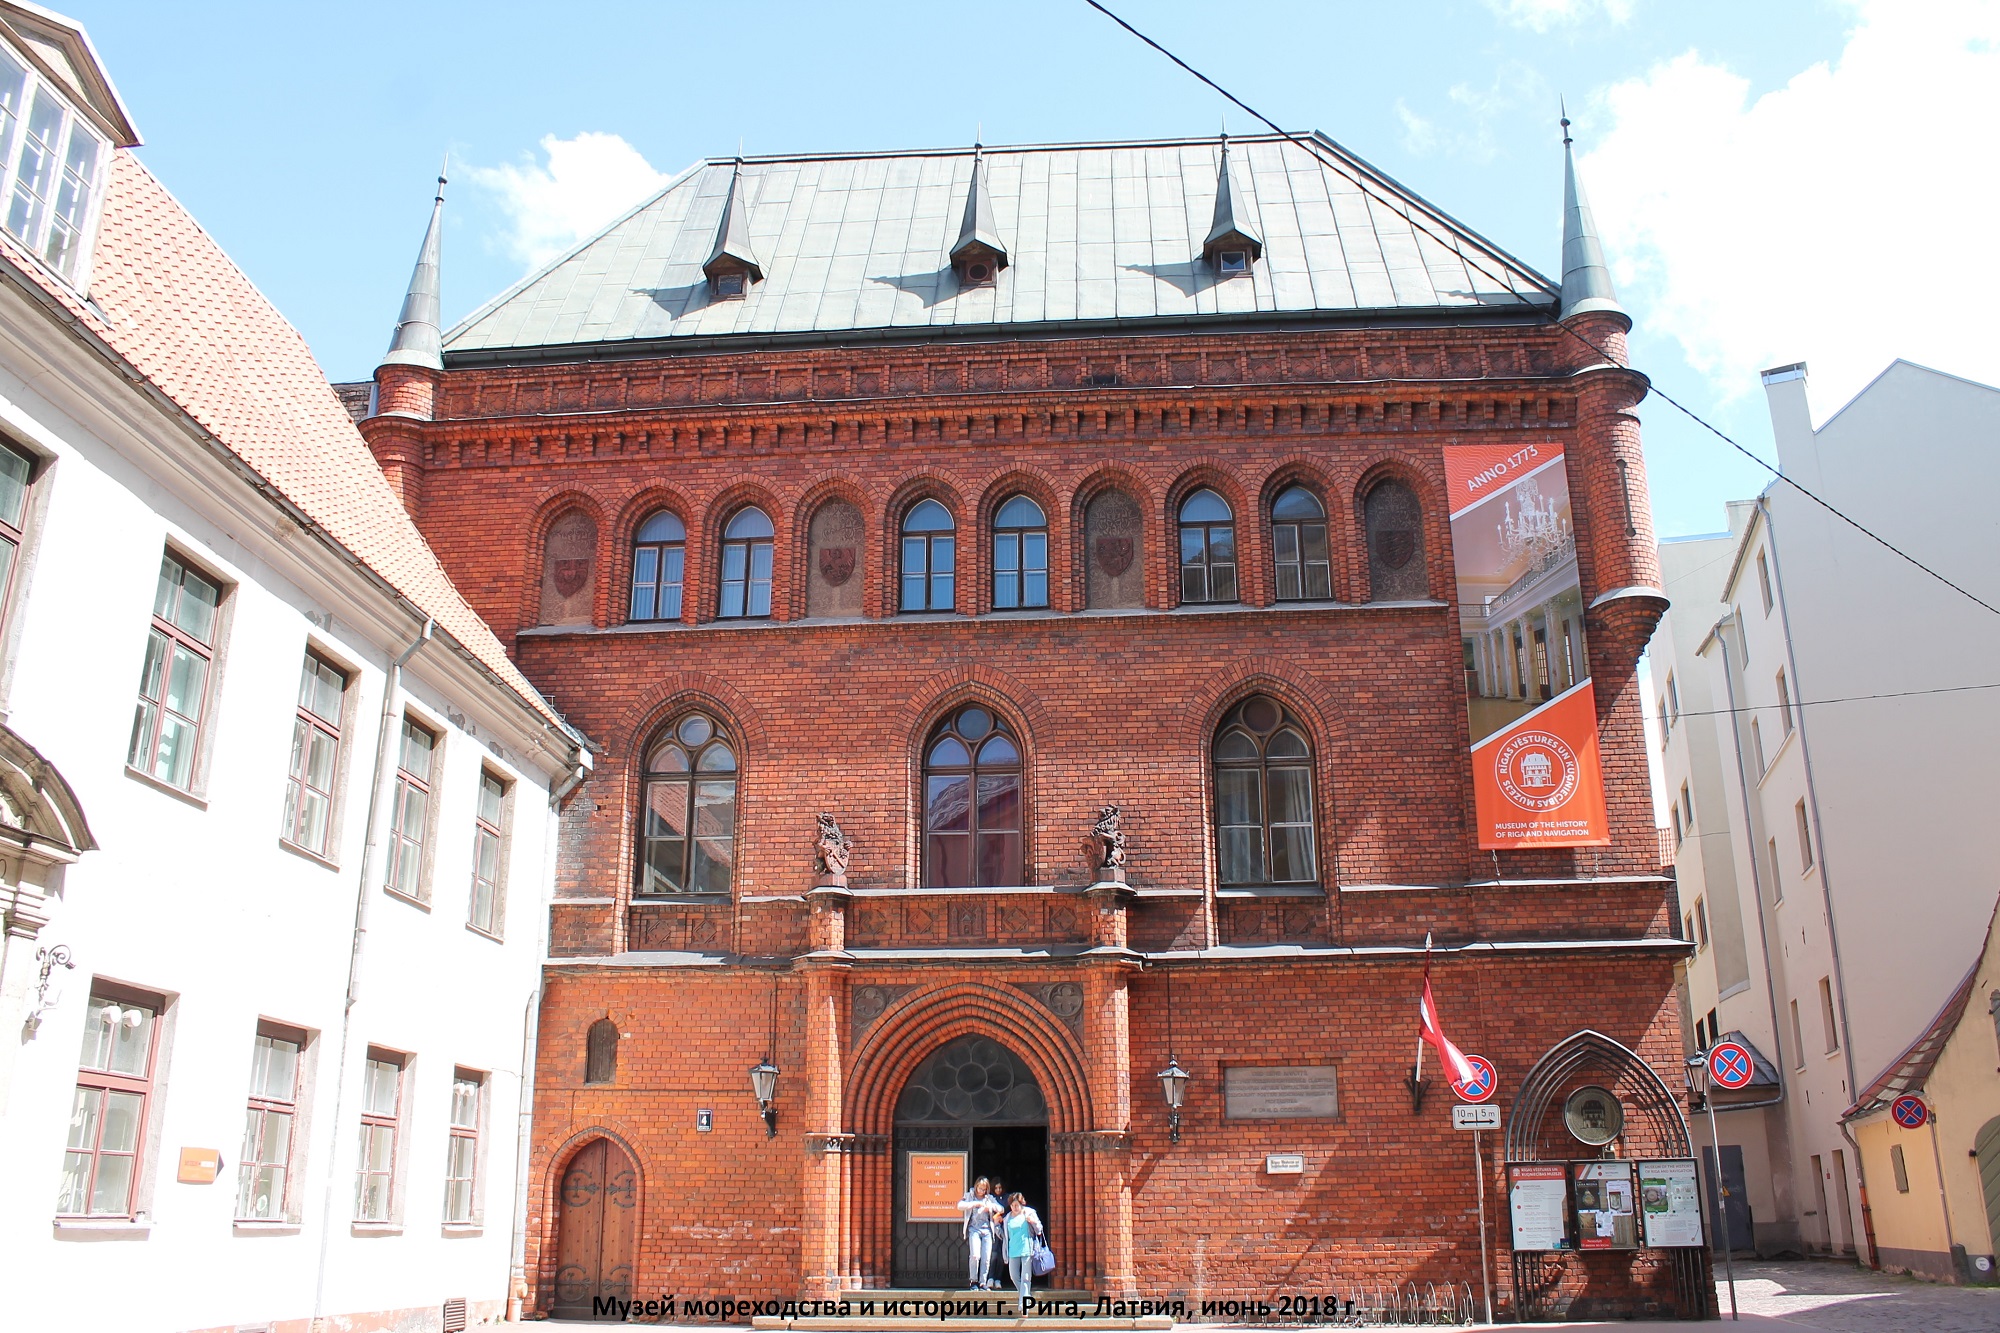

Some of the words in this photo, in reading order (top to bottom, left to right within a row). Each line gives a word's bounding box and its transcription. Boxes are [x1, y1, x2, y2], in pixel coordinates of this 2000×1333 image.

[1467, 463, 1507, 492] ANNO
[1507, 444, 1539, 469] 1773
[1511, 735, 1559, 749] VĒSTURES
[1557, 746, 1571, 760] UN
[1498, 747, 1514, 774] RĪGAS
[1537, 760, 1575, 808] KUĢNIECĪBAS
[1502, 780, 1535, 807] MUZEJS
[1495, 822, 1527, 830] MUSEUM
[1528, 821, 1539, 829] OF
[1556, 820, 1588, 828] HISTORY
[1526, 830, 1542, 838] AND
[1543, 829, 1589, 837] NAVIGATION
[701, 1115, 708, 1126] 4
[1456, 1109, 1466, 1118] 10
[1481, 1109, 1487, 1118] 5
